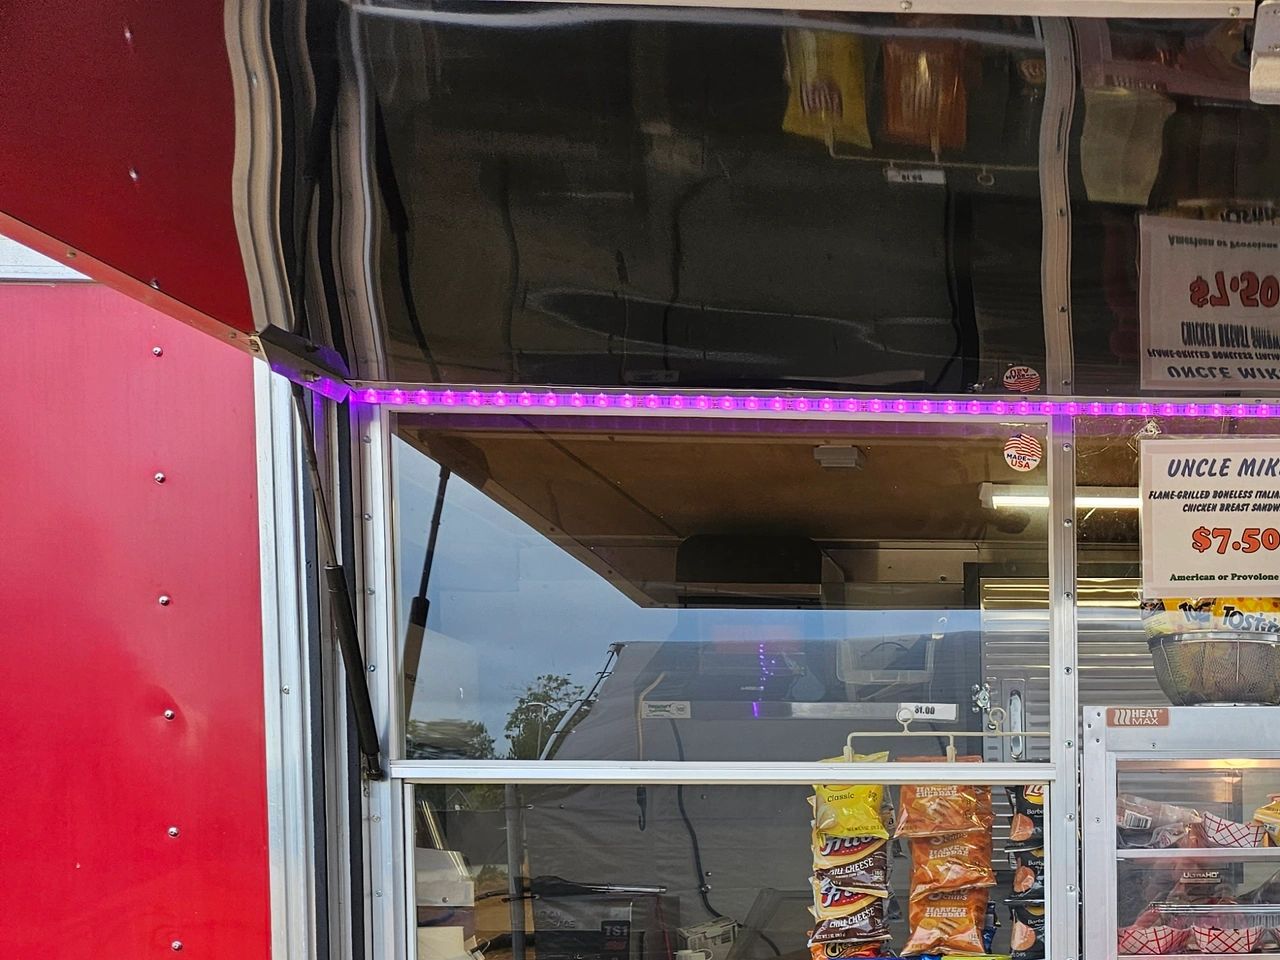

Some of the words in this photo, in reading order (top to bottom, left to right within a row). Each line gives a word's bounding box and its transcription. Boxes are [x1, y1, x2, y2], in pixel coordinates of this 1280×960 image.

[1007, 453, 1027, 461] MADE
[1010, 460, 1030, 469] USA
[1167, 458, 1231, 477] UNCLE
[1149, 490, 1210, 500] FLAME-GRILLED
[1212, 490, 1253, 499] BONELESS
[1182, 503, 1217, 513] CHICKEN
[1219, 503, 1249, 512] BREAST
[1192, 526, 1280, 554] $7.50
[1170, 573, 1215, 581] American
[1230, 573, 1279, 581] Provolone
[1132, 709, 1159, 718] HEAT
[827, 793, 855, 803] Classic
[845, 857, 874, 873] CHEESE
[848, 906, 875, 923] CHEESE
